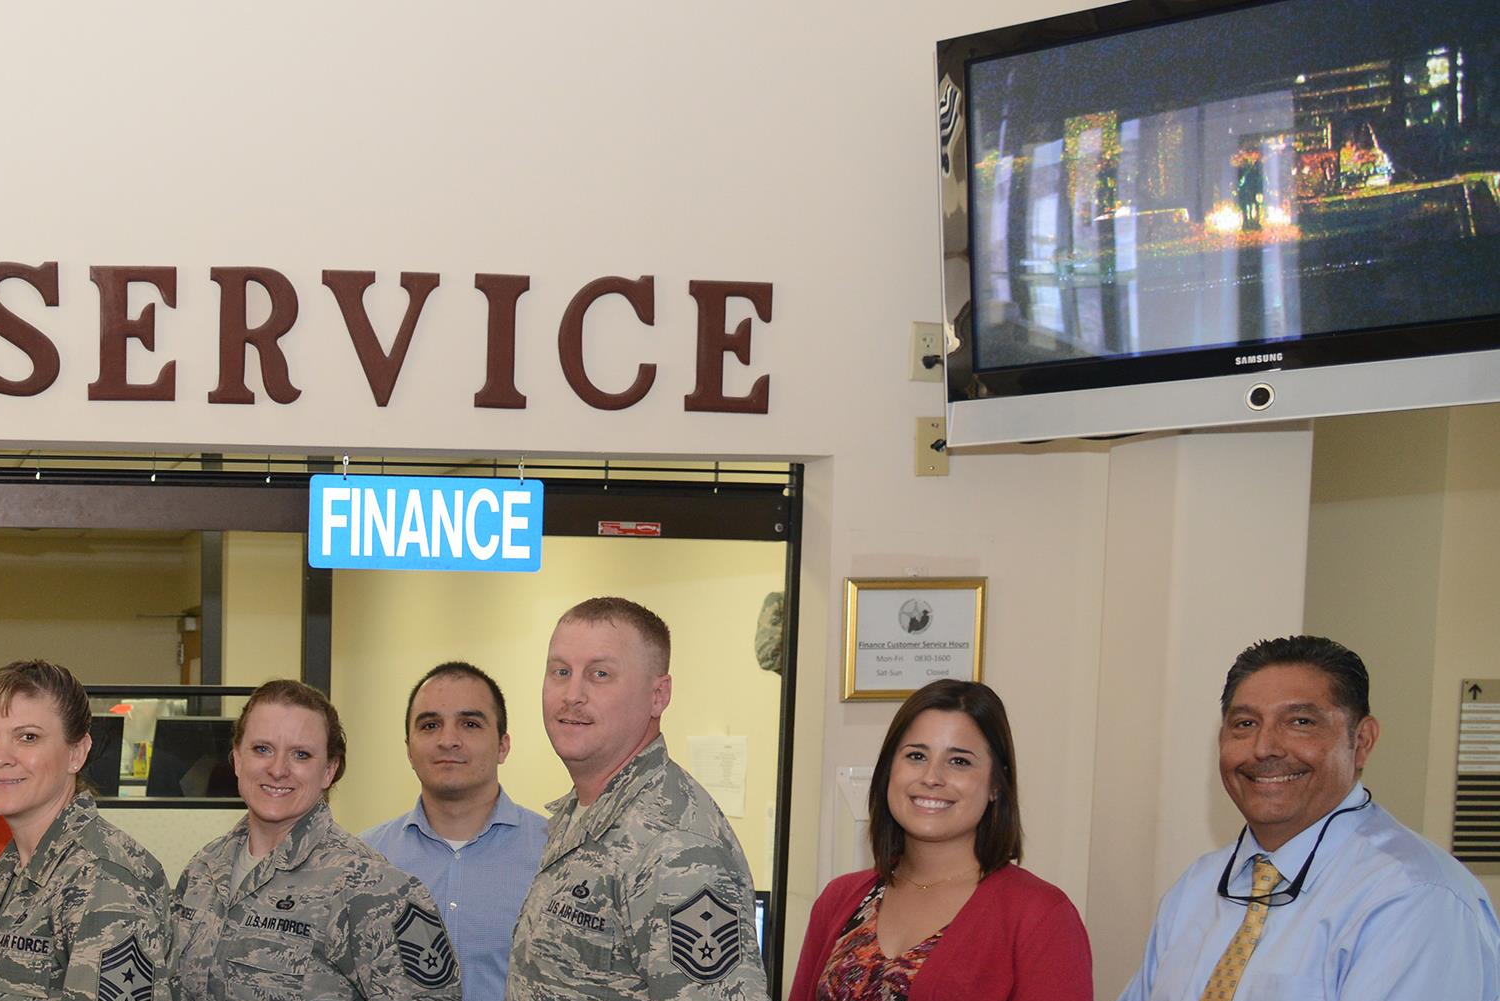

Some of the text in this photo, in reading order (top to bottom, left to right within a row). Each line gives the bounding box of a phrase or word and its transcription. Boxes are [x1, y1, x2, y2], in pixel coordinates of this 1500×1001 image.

[1235, 352, 1283, 366] SAMSUNG
[321, 486, 530, 561] FINANCE
[858, 641, 969, 649] Finance Customer Service Hours
[261, 916, 276, 931] AIR
[276, 918, 312, 937] FORCE
[560, 904, 573, 920] AIR
[571, 910, 606, 931] FORCE
[0, 934, 11, 948] AIR
[11, 935, 50, 954] FORCE
